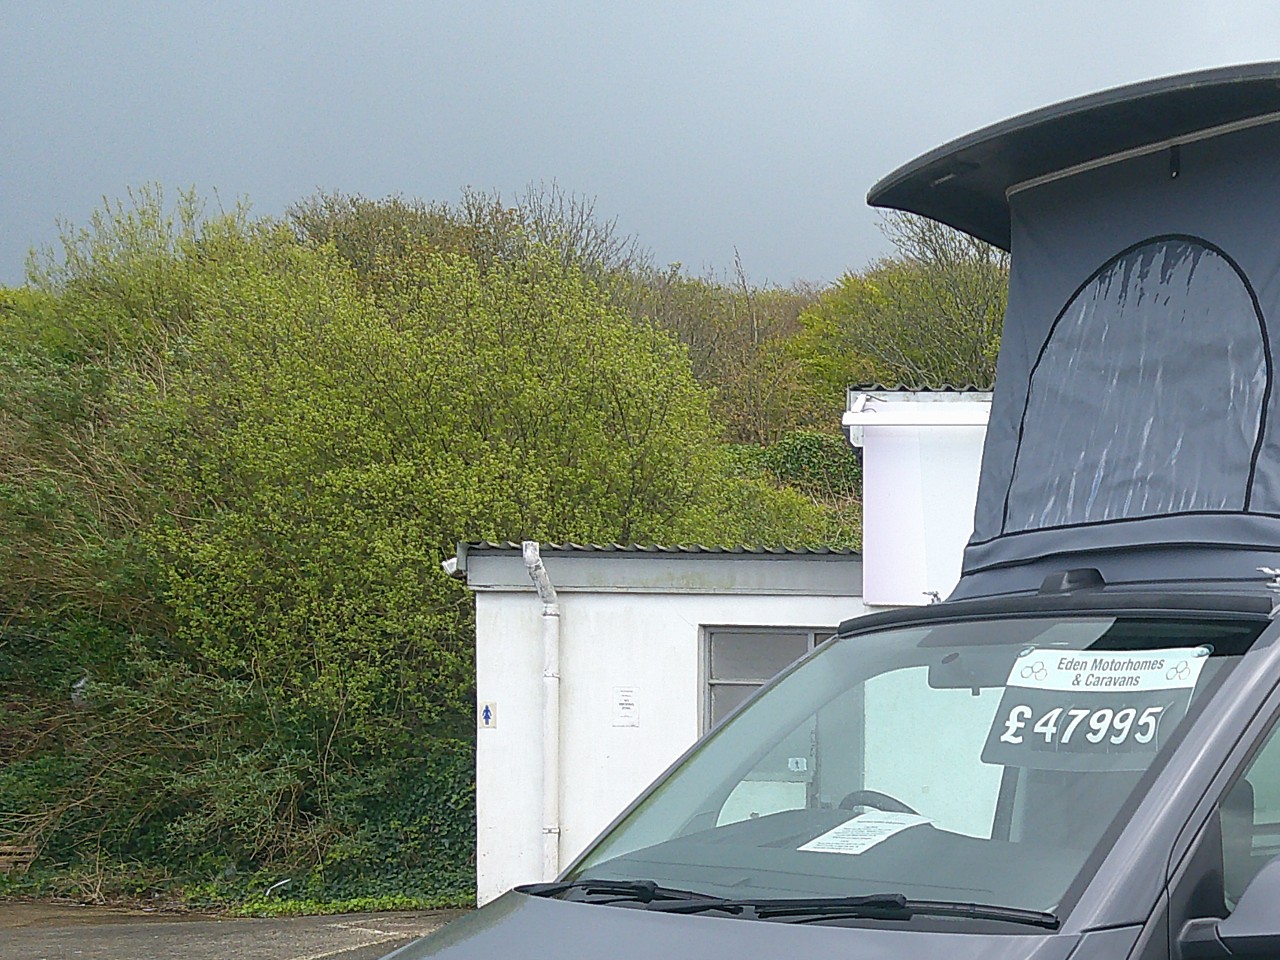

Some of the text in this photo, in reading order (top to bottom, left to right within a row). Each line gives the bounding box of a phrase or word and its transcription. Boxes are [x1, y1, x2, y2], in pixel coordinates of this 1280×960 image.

[1057, 658, 1165, 672] Eden Motorhomes
[1072, 673, 1141, 687] & Caravans
[1000, 704, 1164, 744] £47995
